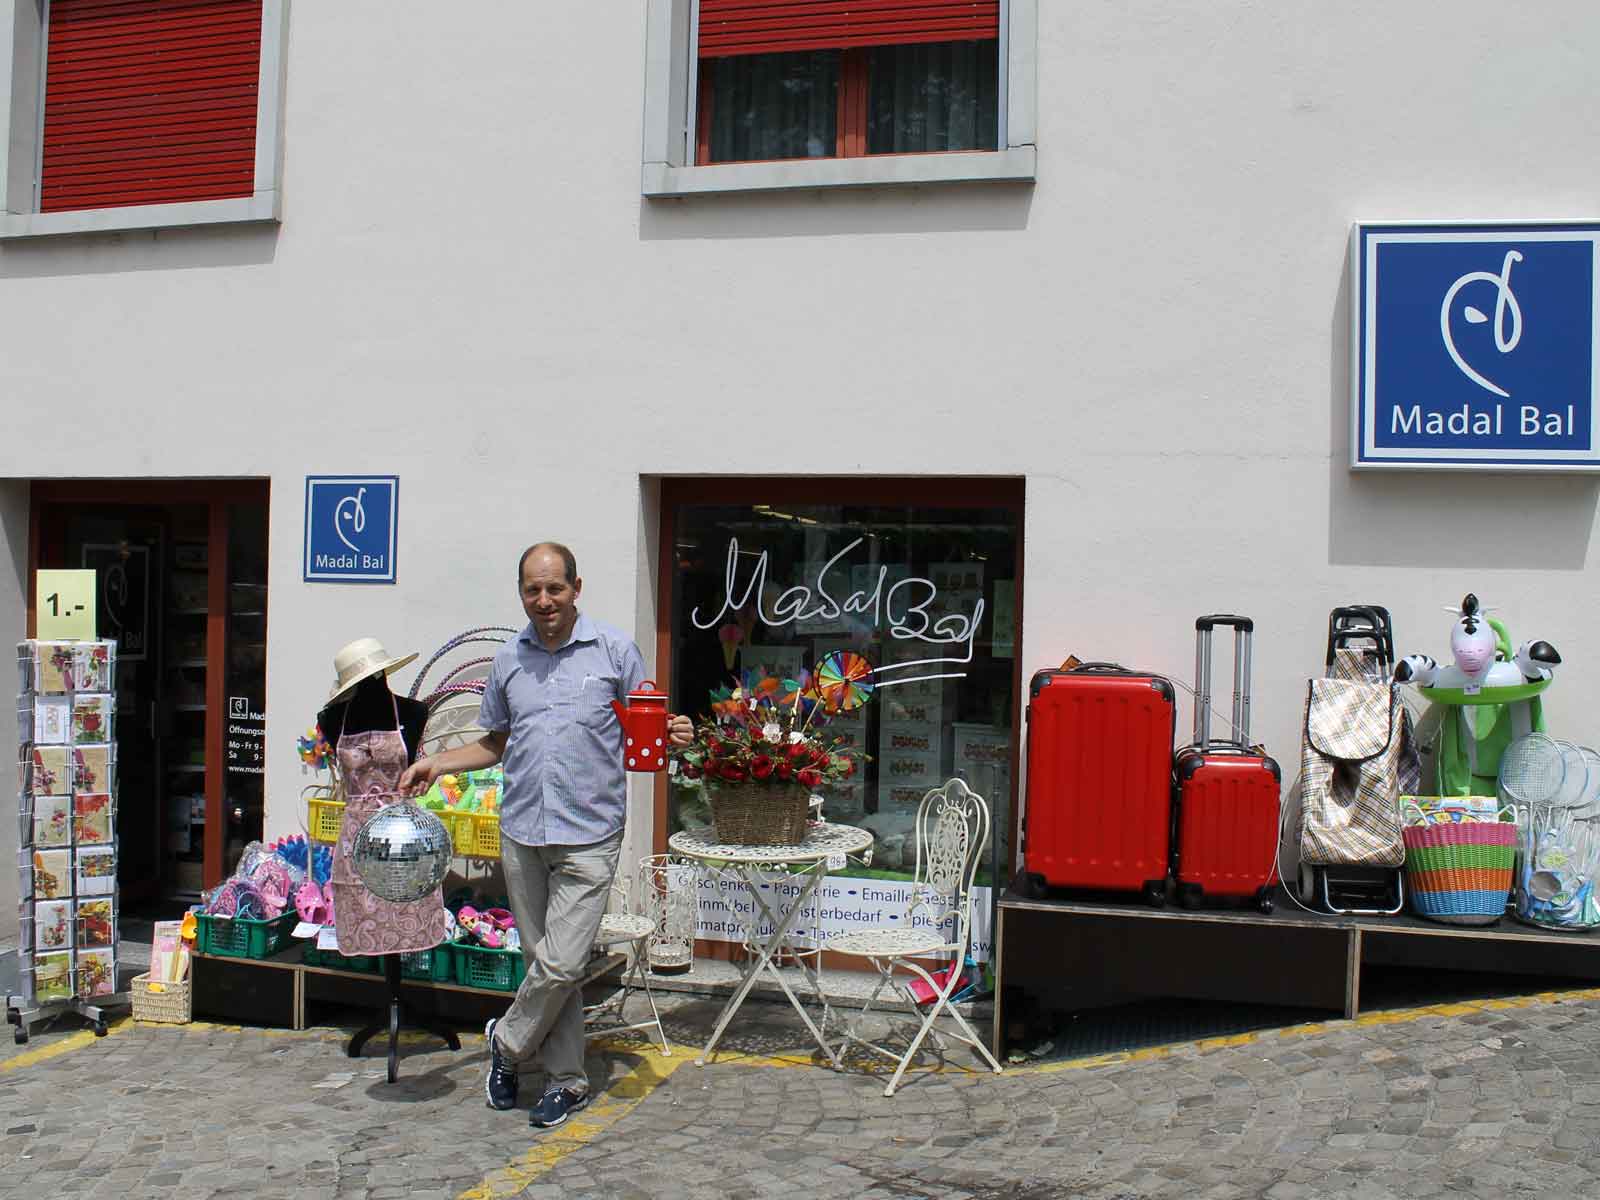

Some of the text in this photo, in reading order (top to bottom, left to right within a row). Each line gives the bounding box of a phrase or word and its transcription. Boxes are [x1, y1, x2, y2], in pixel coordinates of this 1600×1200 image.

[1391, 404, 1574, 436] Madal Bal
[316, 554, 384, 569] Madal Bal
[47, 592, 84, 616] 1.-
[229, 740, 240, 749] Mo
[244, 742, 253, 750] Fr
[229, 750, 238, 759] Sa
